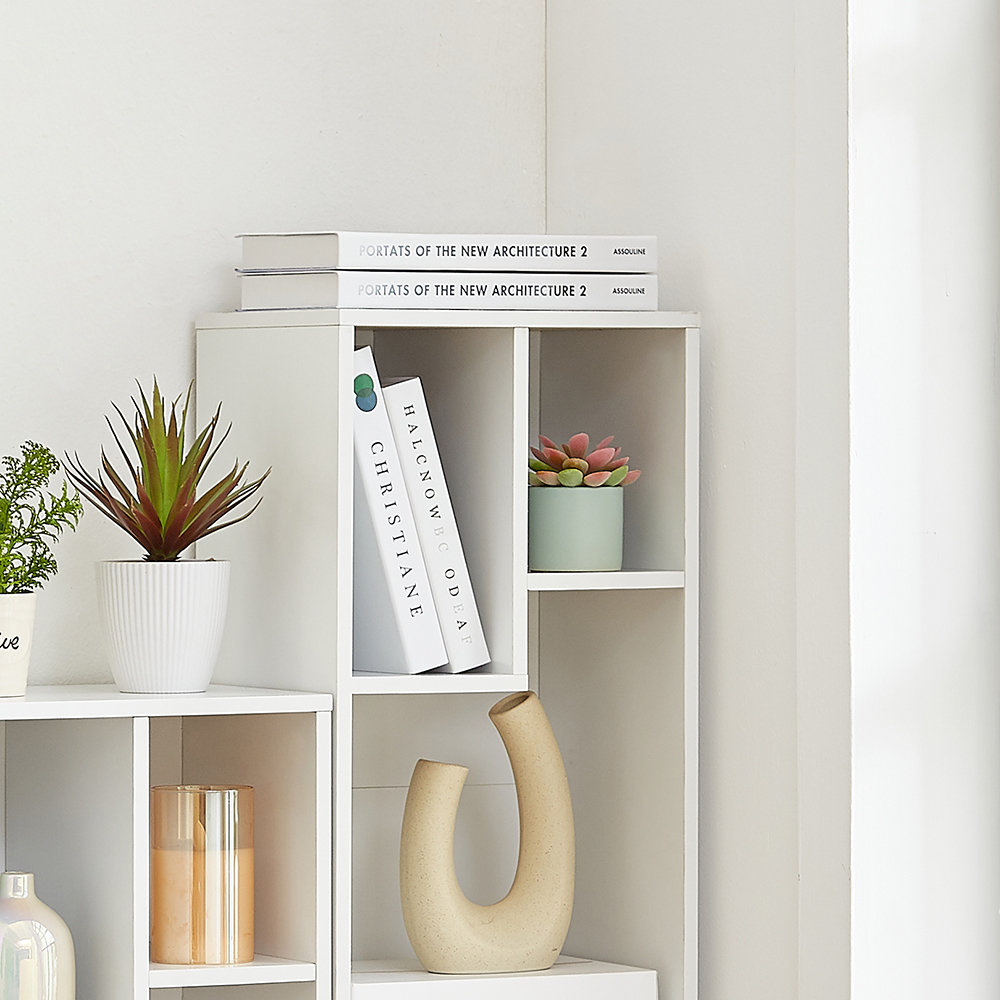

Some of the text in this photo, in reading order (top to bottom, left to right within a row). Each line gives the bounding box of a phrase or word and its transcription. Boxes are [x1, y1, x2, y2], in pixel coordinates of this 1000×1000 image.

[359, 245, 588, 258] PORTATS OF THE NEW ARCHITECTURE 2
[612, 248, 646, 256] ASSOULINE
[358, 284, 587, 297] PORTATS OF THE NEW ARCHITECTURE 2
[612, 287, 646, 295] ASSOULINE
[370, 441, 424, 618] CHRISTIANE
